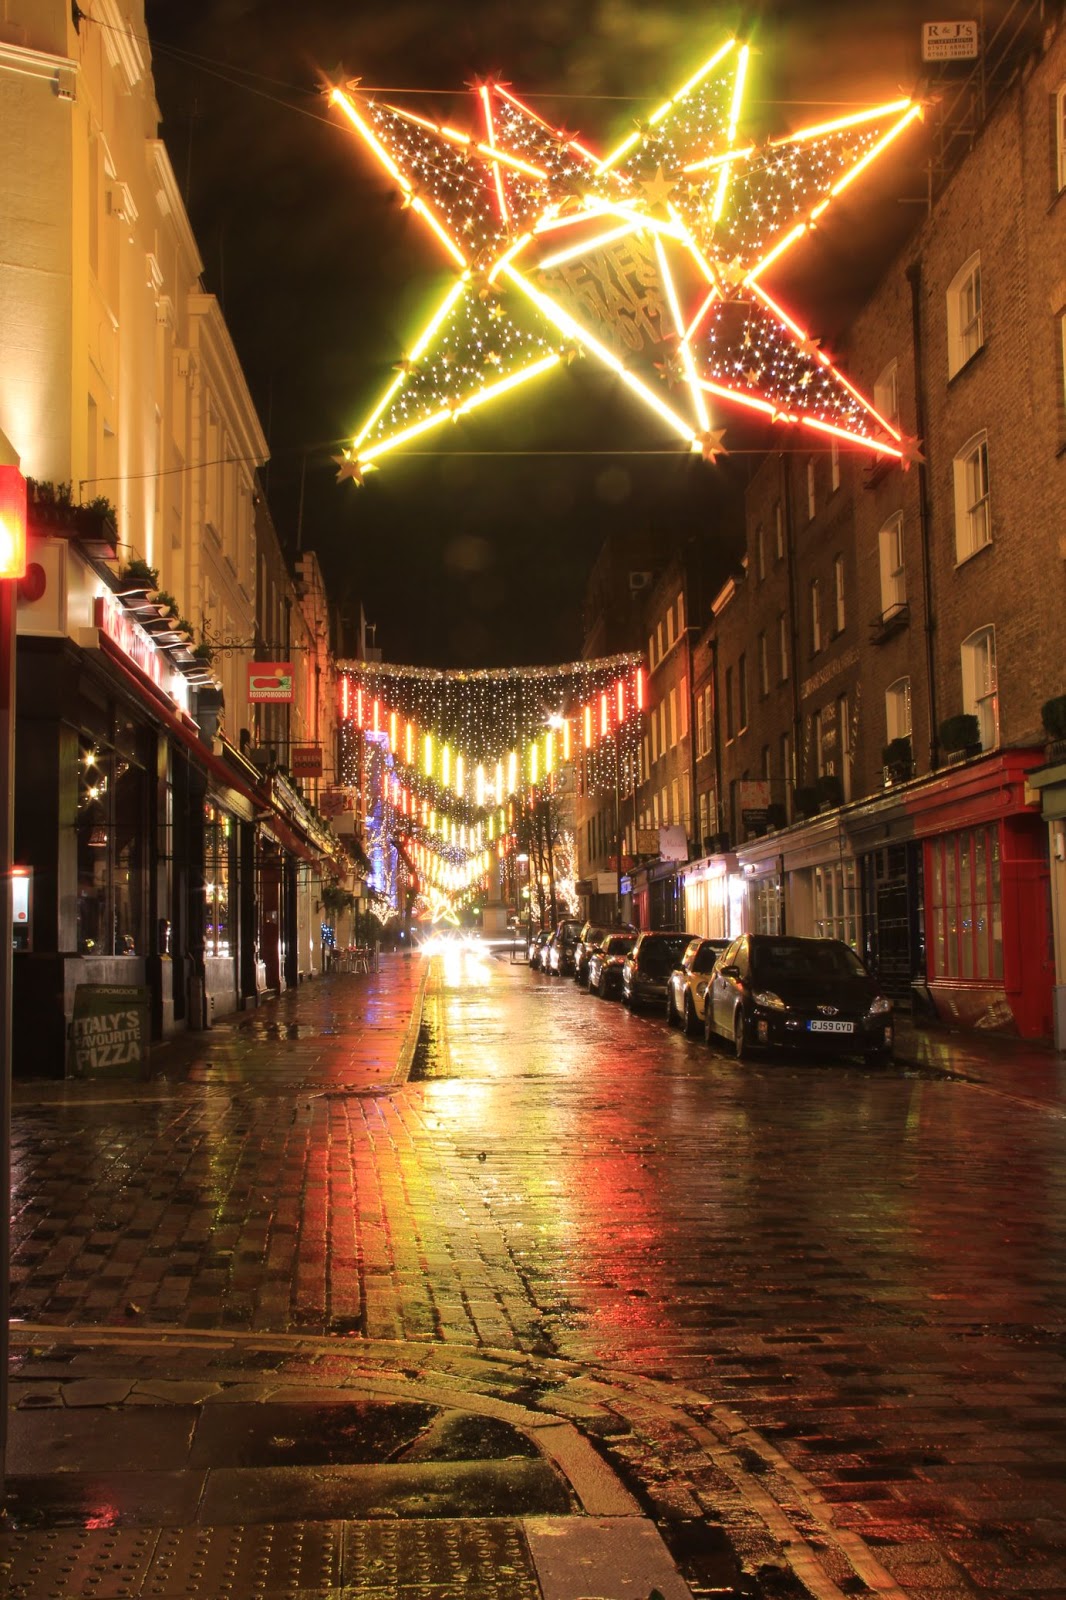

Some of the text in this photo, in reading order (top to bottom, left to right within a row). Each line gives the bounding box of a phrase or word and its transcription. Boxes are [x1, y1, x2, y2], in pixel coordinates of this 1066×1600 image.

[928, 24, 973, 37] R & J's
[74, 1010, 140, 1037] ITALY'S
[811, 1021, 852, 1032] GJ59 GYD
[76, 1041, 140, 1071] PIZZA
